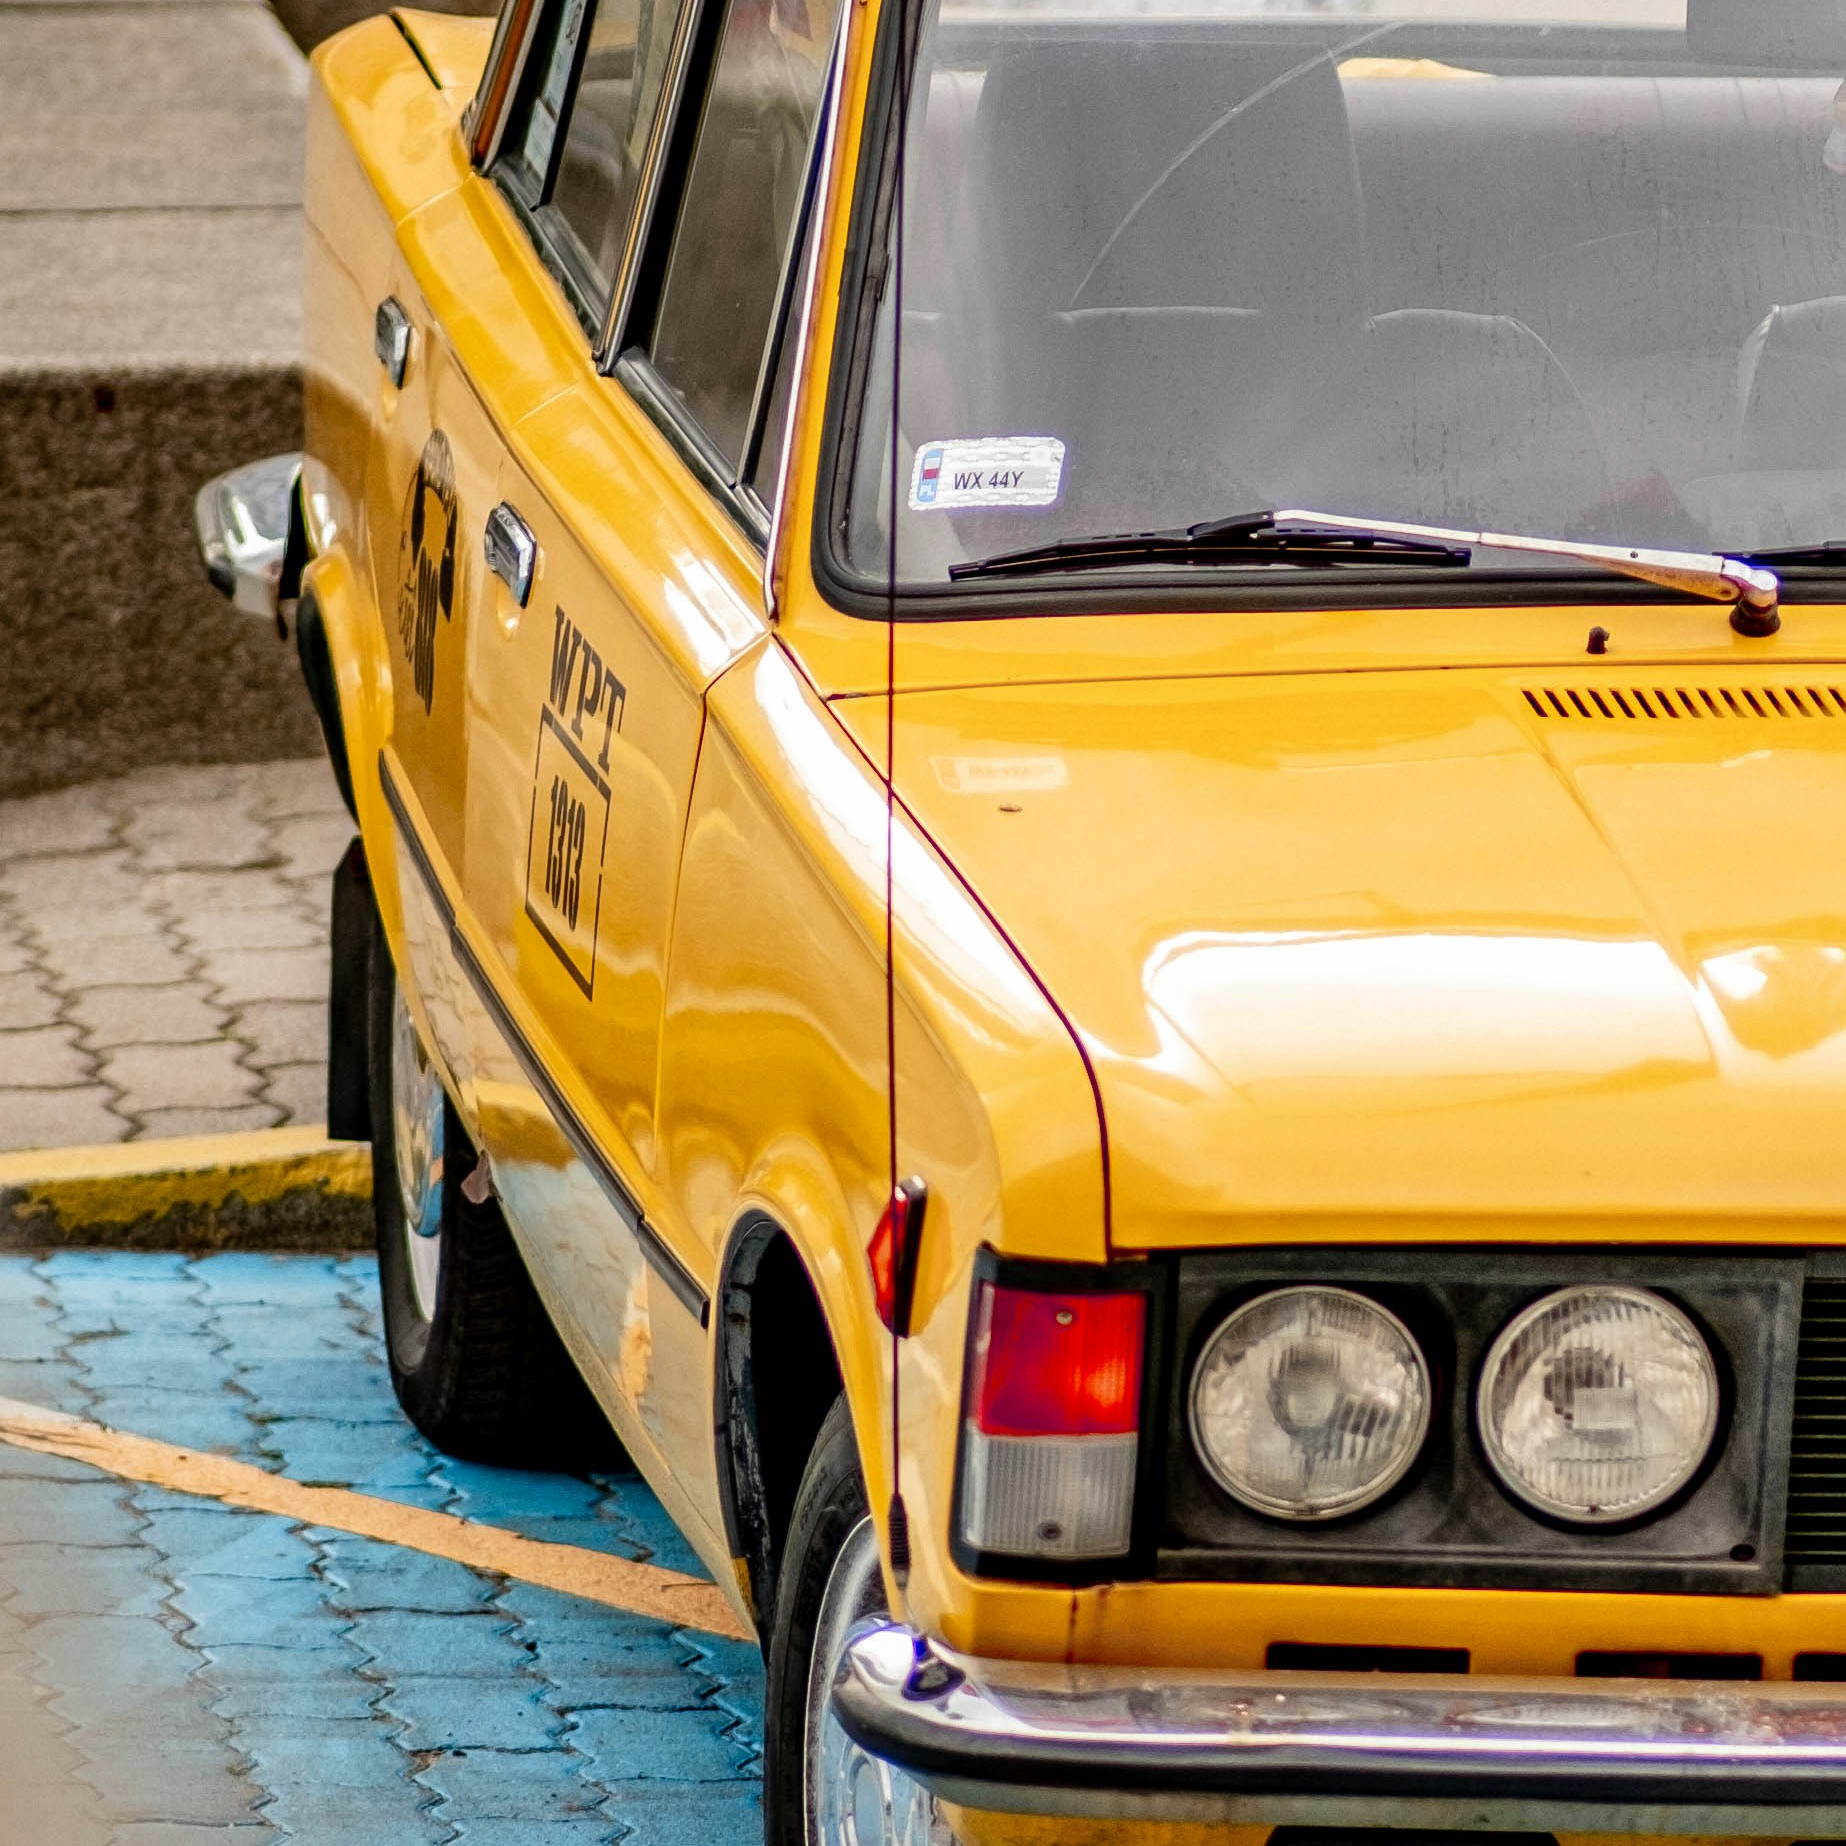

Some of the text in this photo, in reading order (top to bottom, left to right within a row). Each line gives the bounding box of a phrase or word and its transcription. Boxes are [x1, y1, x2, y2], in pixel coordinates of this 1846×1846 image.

[953, 470, 1025, 490] WX 44Y
[547, 603, 629, 775] WPT
[544, 774, 587, 932] 1313
